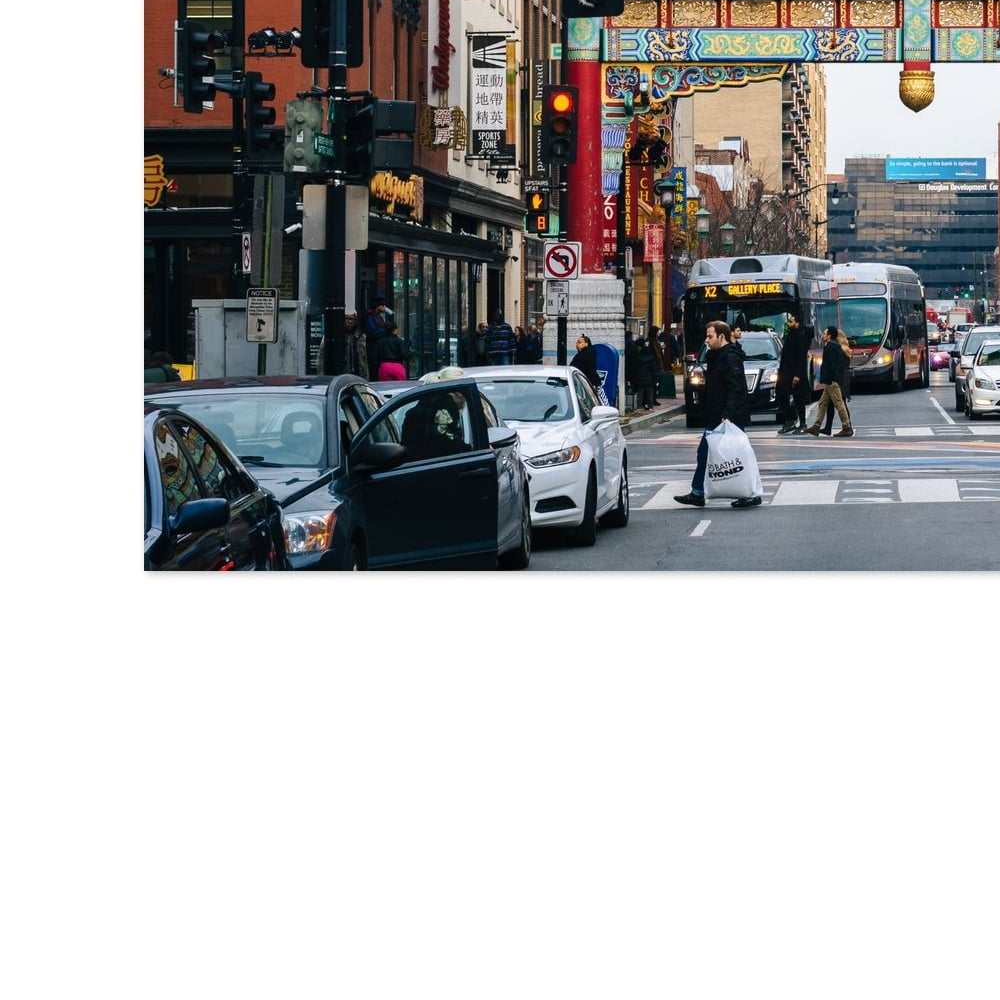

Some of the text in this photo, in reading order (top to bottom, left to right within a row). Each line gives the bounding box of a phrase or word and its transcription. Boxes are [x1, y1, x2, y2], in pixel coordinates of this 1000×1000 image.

[478, 131, 502, 141] SPORTS
[481, 140, 498, 149] ZONE
[950, 183, 987, 191] Development
[704, 283, 781, 298] X2 GALLERY PLACE
[715, 459, 734, 472] BATH
[735, 457, 742, 466] &
